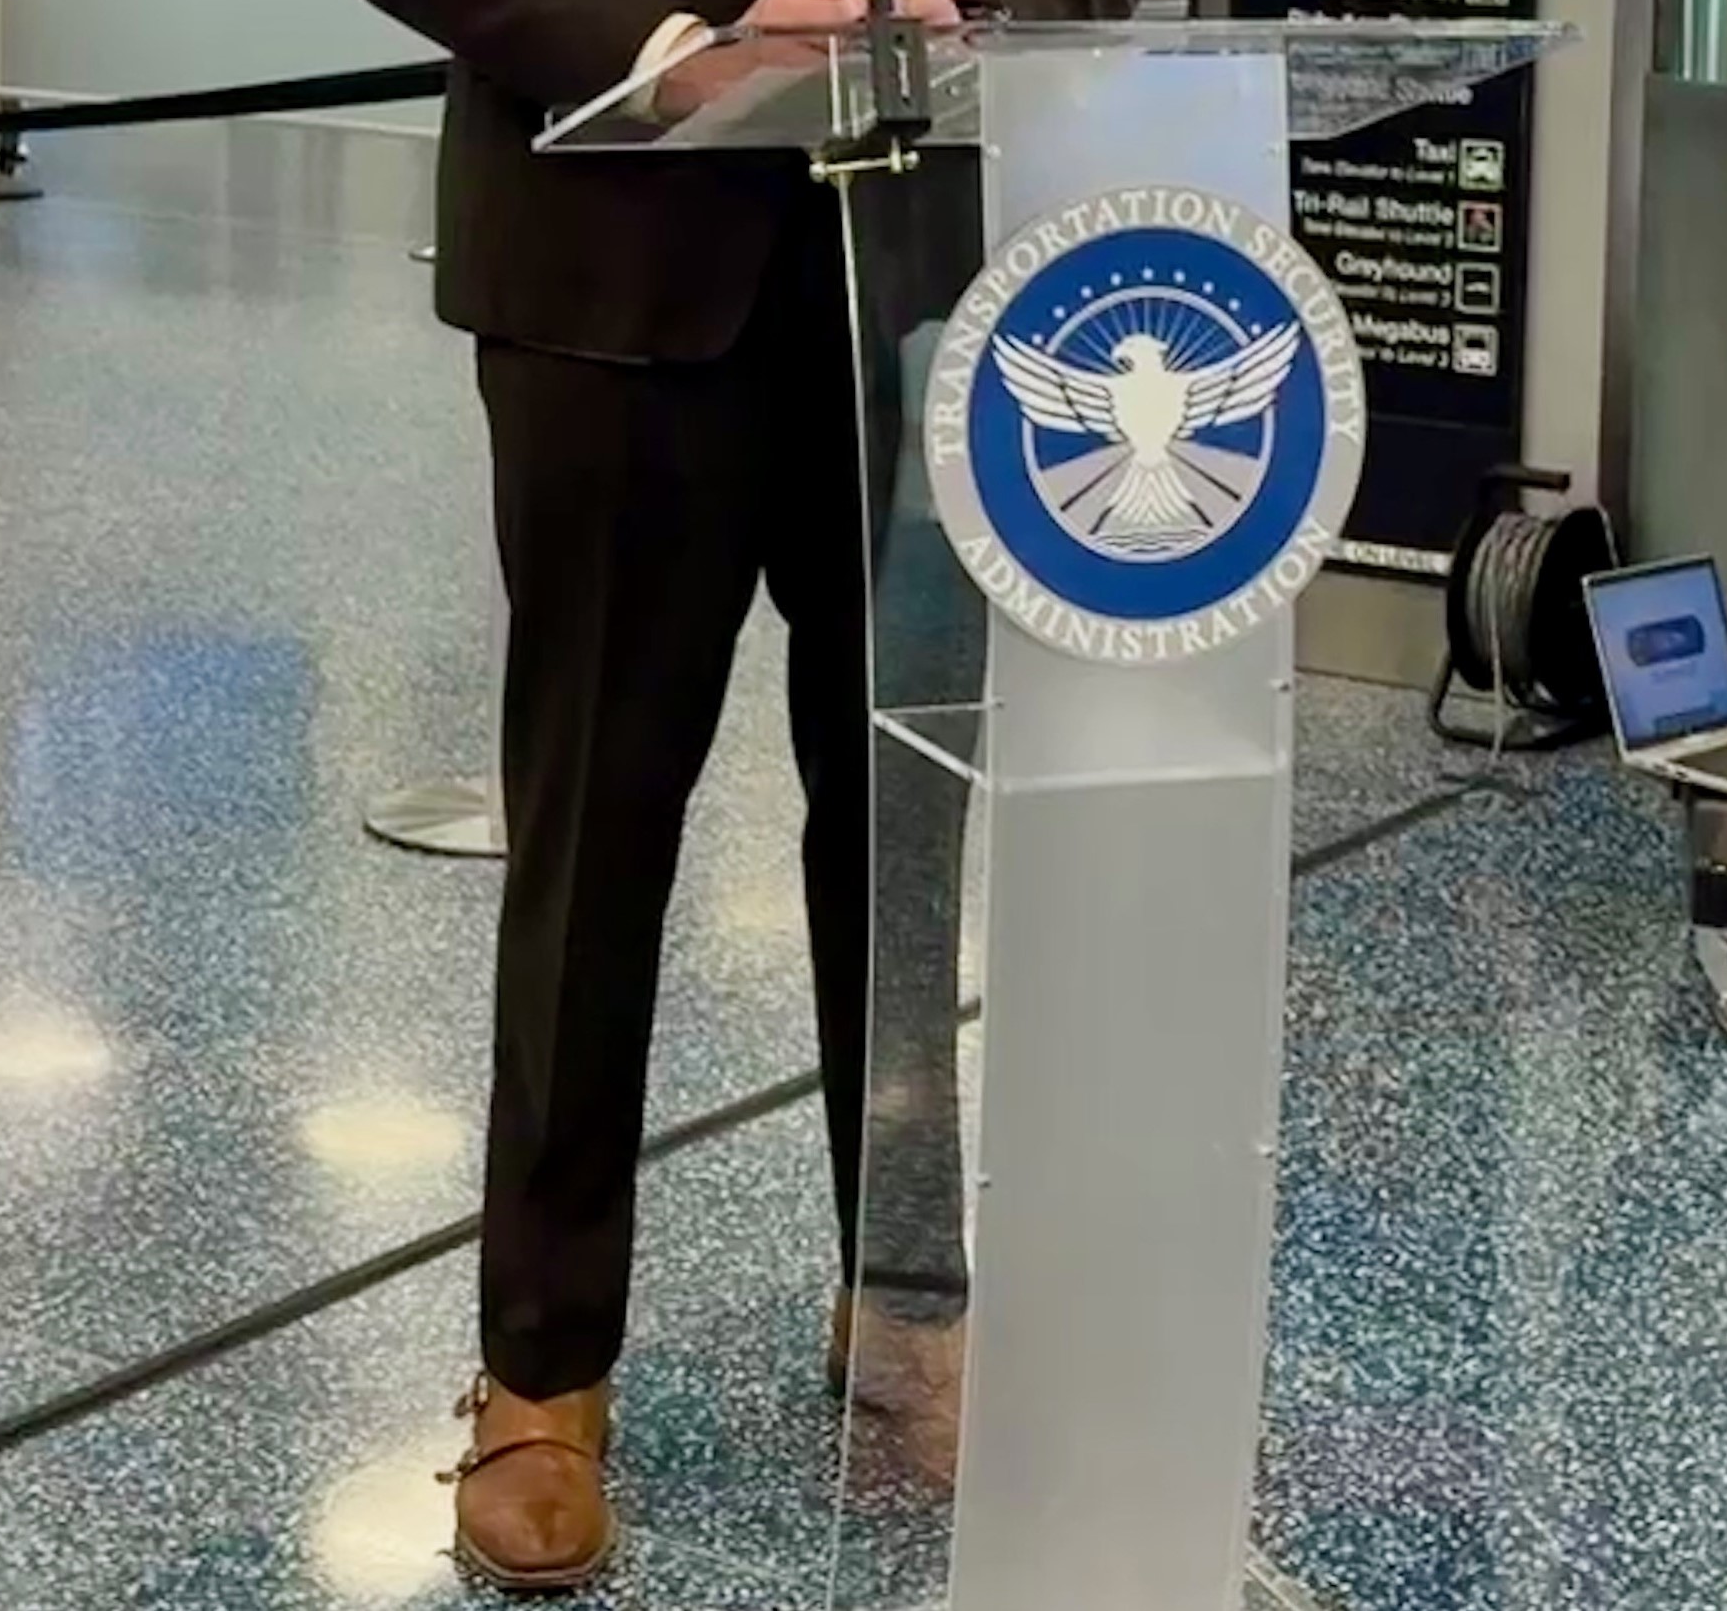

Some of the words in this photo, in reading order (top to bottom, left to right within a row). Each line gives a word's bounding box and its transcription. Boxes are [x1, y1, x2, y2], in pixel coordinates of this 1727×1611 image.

[1414, 138, 1457, 163] Taxi
[1294, 190, 1370, 219] Tri-Rail
[1375, 197, 1455, 225] Shuttle
[1335, 250, 1454, 286] Greyhound
[933, 188, 1242, 465] TRANSPORTATION
[1246, 223, 1361, 446] SECURITY
[1352, 311, 1451, 346] Megabus
[959, 514, 1333, 662] ADMINISTRATION
